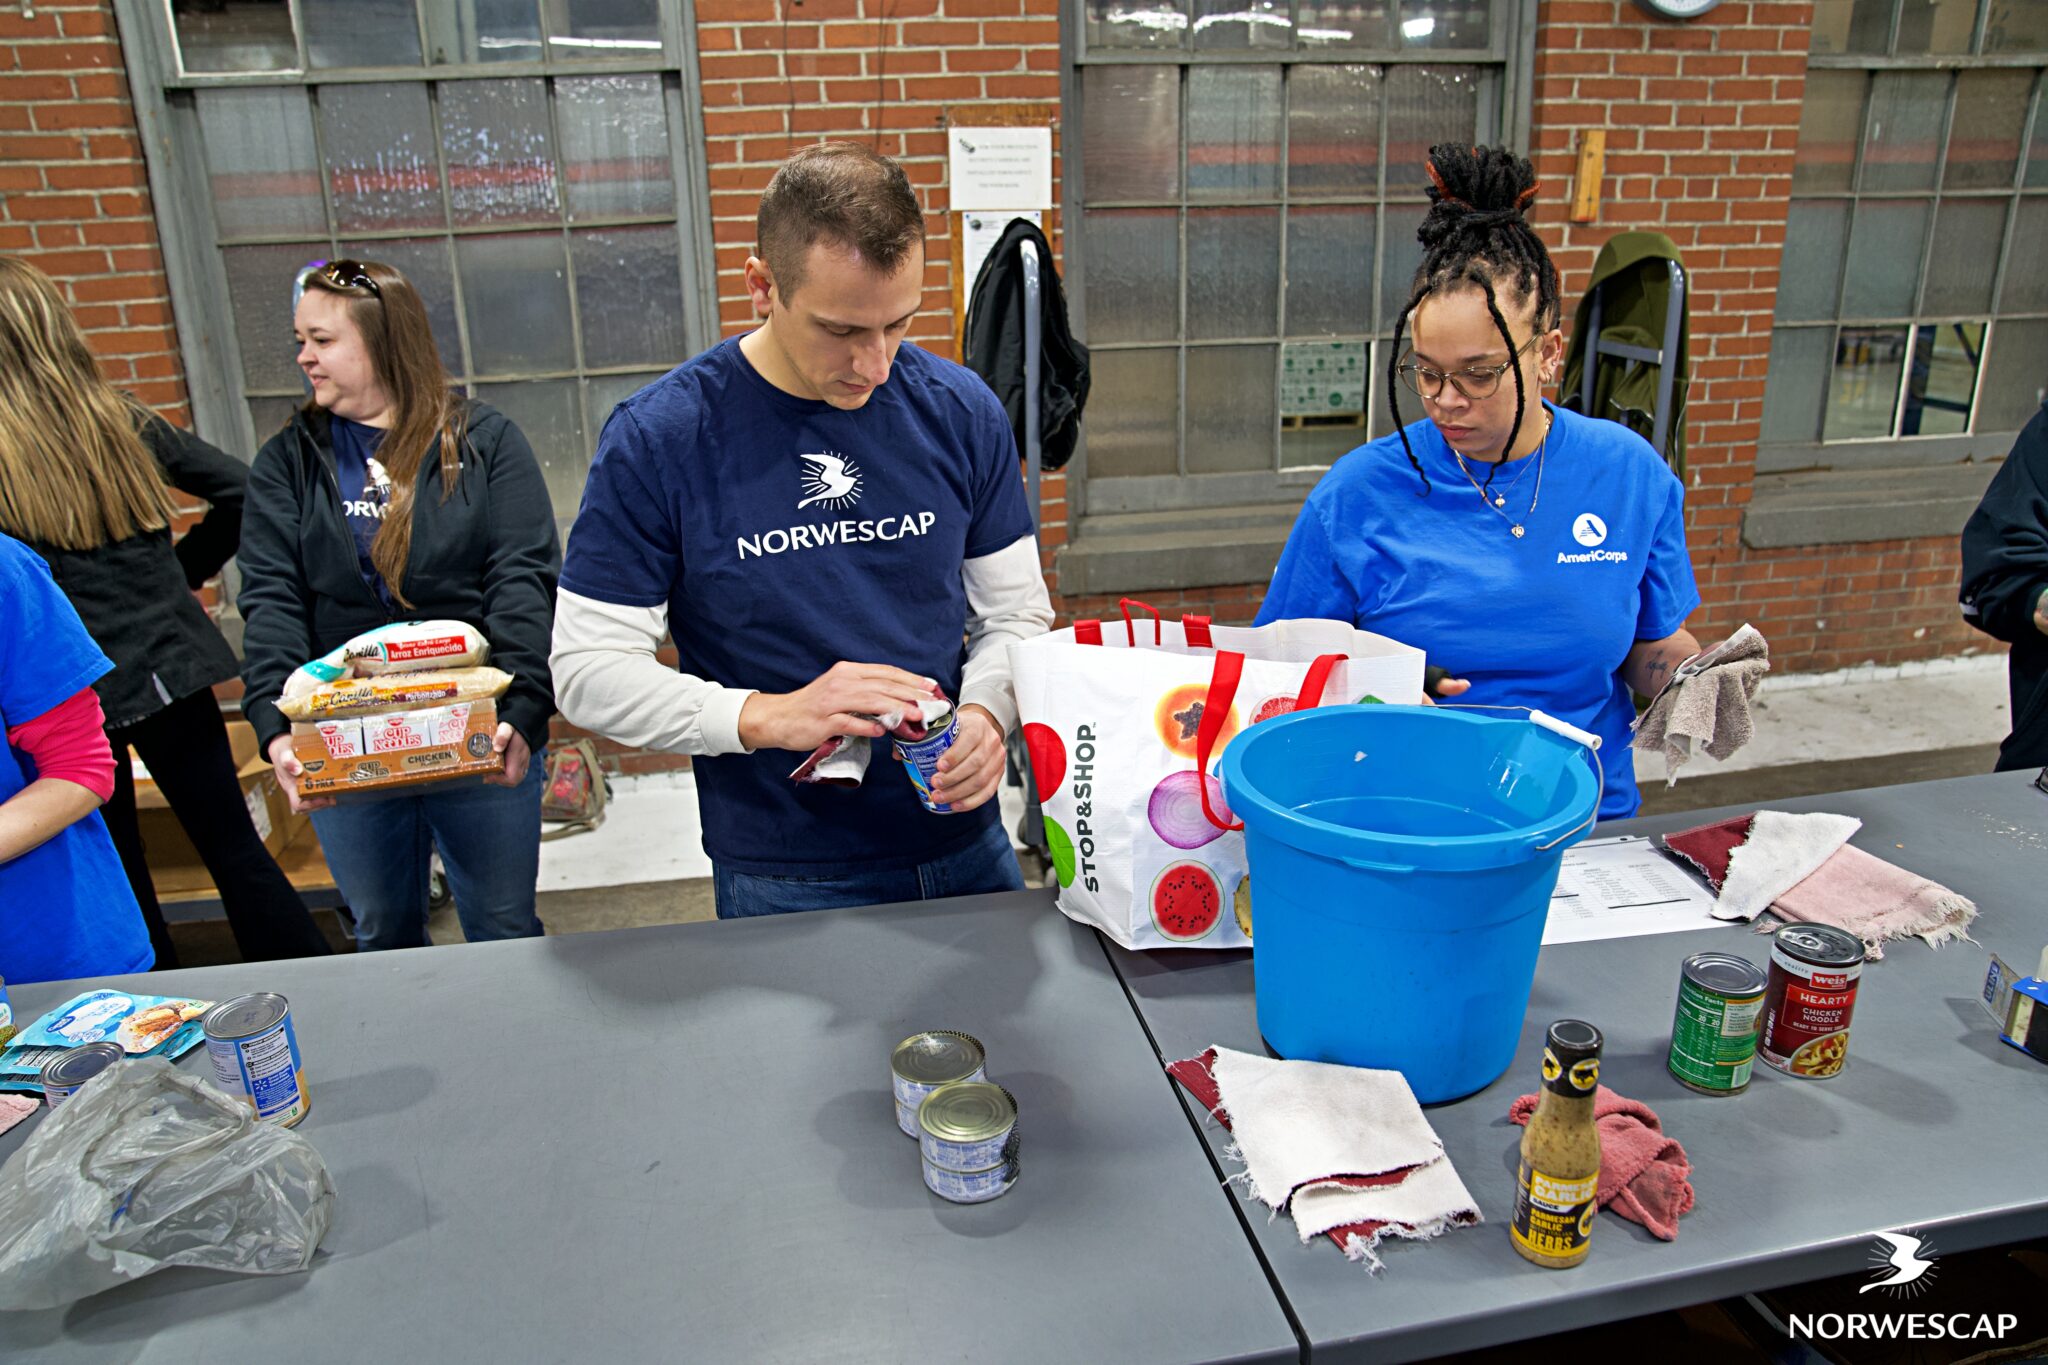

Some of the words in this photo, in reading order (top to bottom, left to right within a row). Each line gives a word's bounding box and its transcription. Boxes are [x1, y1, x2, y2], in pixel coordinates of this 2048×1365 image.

[737, 511, 936, 560] NORWESCAP
[1557, 549, 1628, 564] AmeriCorps
[391, 649, 412, 660] Arroz
[414, 643, 463, 658] Enriquecido
[384, 726, 410, 740] CUP
[373, 734, 422, 752] NOODLES
[407, 751, 452, 765] CHICKEN
[304, 777, 314, 790] 6
[1073, 724, 1099, 893] STOP&SHOP
[1813, 975, 1846, 985] weis
[1800, 992, 1848, 1005] HEARTY
[1802, 1007, 1842, 1017] CHICKEN
[1803, 1014, 1840, 1023] NOODLE
[1534, 1185, 1593, 1202] GARLIC
[1530, 1216, 1563, 1231] GARLIC
[1531, 1208, 1576, 1224] PARMESAN
[1528, 1228, 1573, 1250] HERBS
